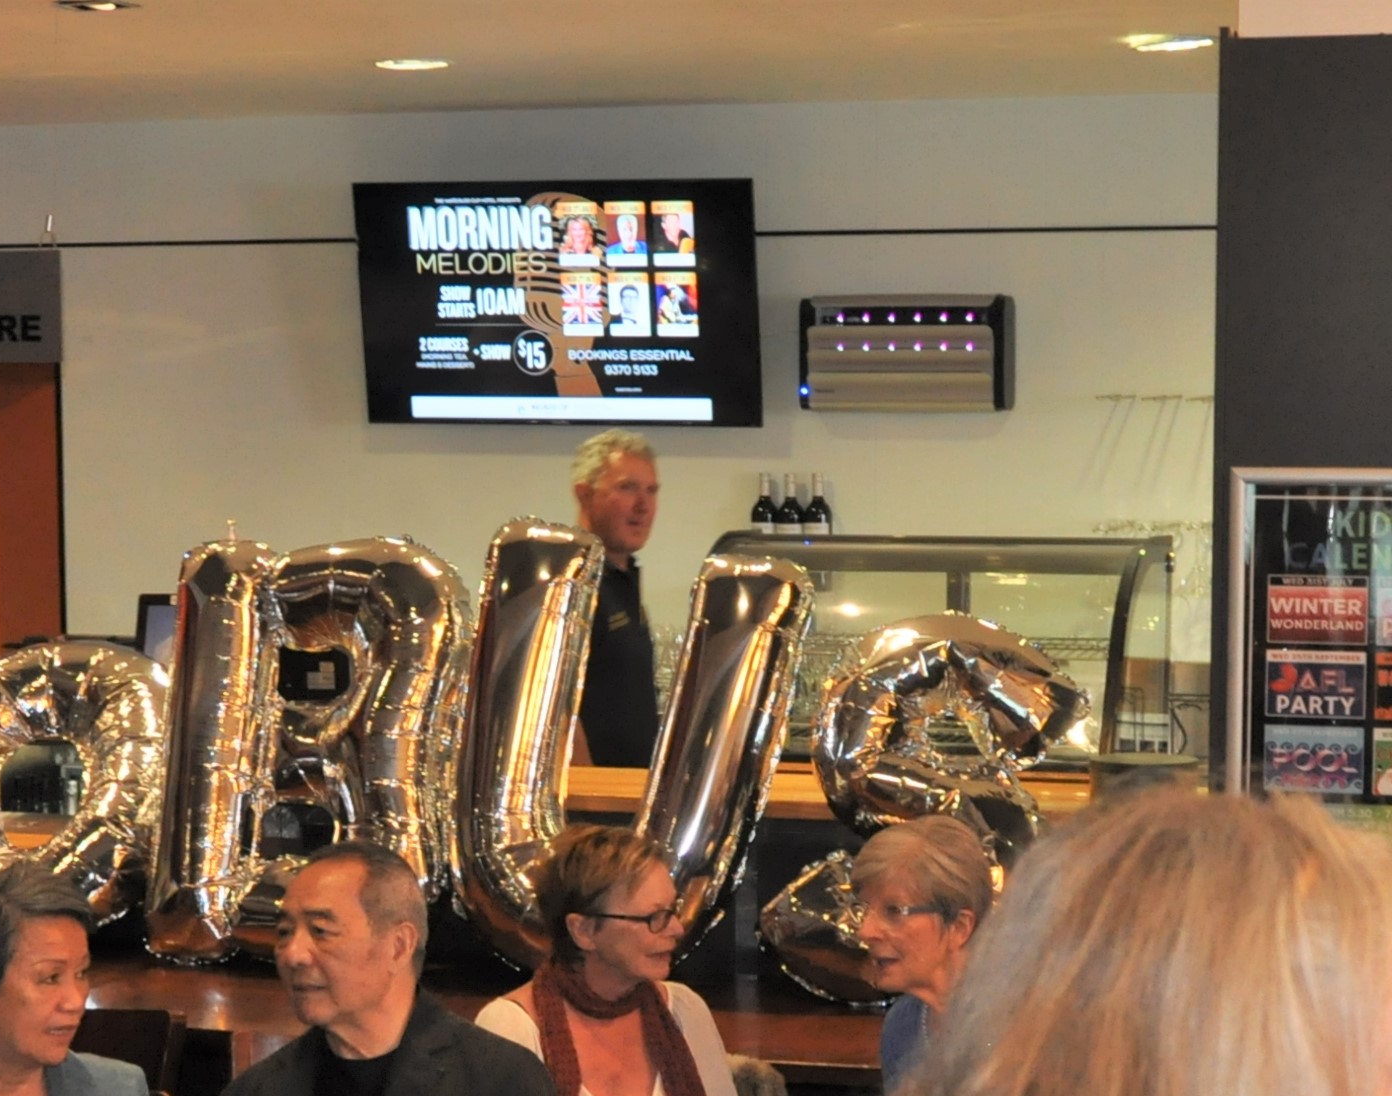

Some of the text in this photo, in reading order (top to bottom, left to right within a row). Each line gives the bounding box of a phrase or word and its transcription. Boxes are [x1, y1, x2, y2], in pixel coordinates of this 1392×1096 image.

[406, 205, 554, 251] MORNING
[416, 252, 548, 275] MELODIES
[439, 285, 471, 301] SHOW
[476, 287, 526, 315] 10AM
[437, 302, 476, 318] STARTS
[480, 344, 511, 360] SHOW
[517, 337, 547, 369] $15
[567, 349, 695, 361] BOOKINGS ESSENTIAL
[604, 364, 631, 376] 9370
[1270, 597, 1363, 616] WINTER
[1270, 618, 1365, 632] WONDERLAND
[1276, 694, 1356, 716] PARTY
